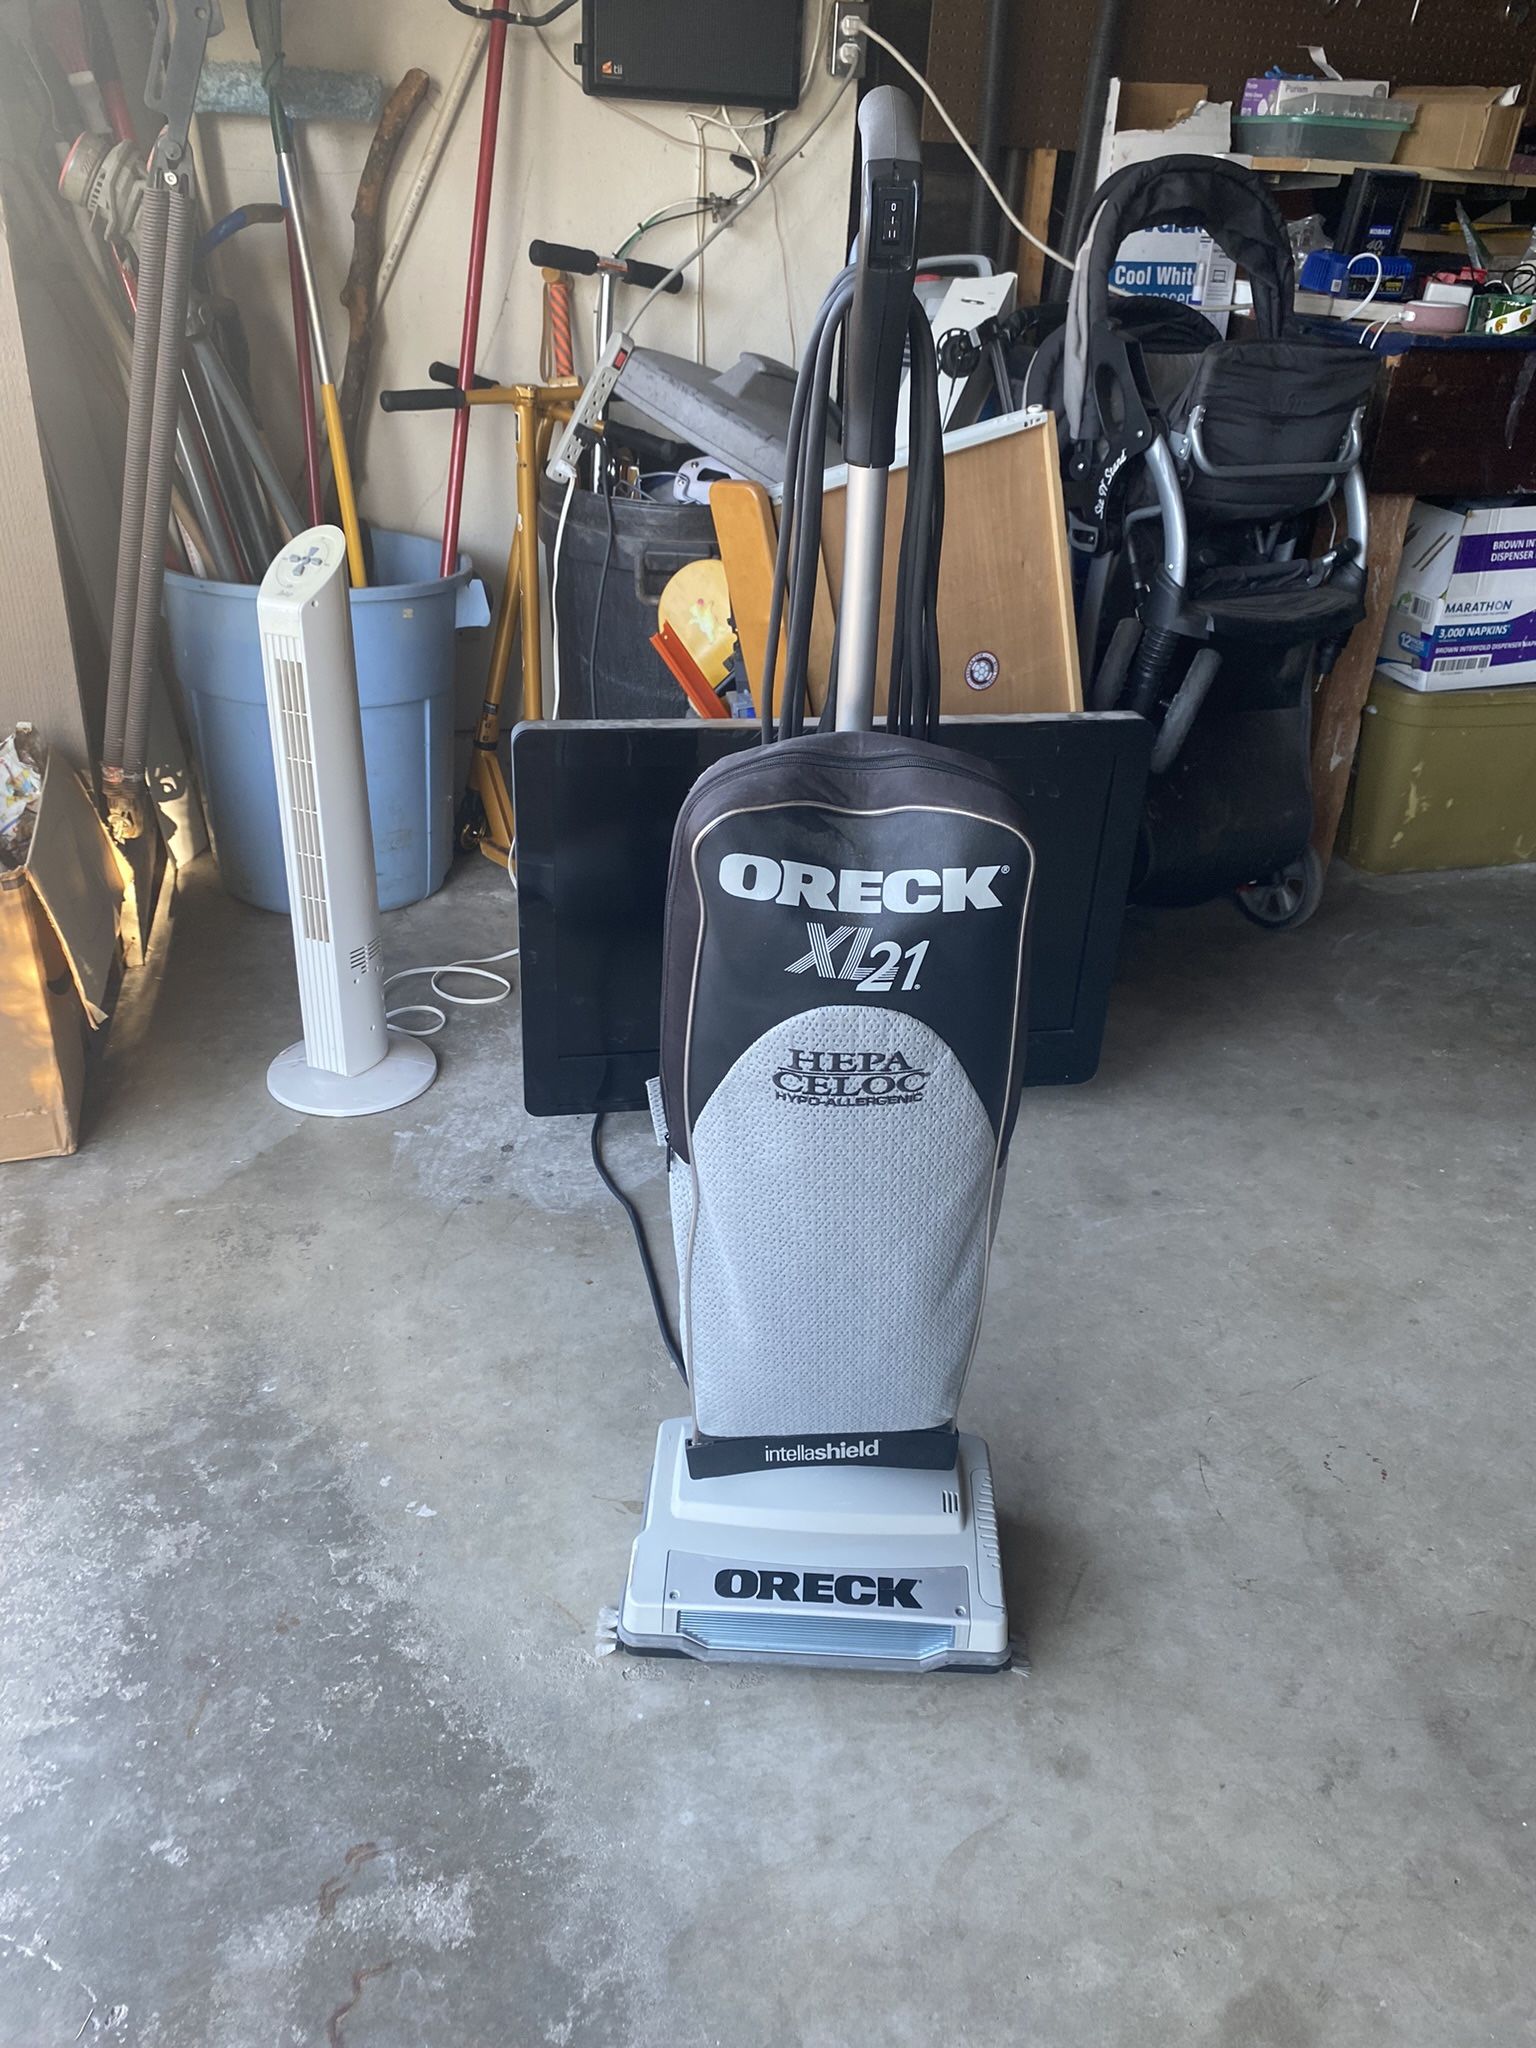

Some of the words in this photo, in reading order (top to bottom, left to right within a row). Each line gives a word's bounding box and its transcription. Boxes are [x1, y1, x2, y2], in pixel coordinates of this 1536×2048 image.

[1114, 264, 1152, 285] Cool
[1156, 265, 1197, 285] Whit
[1104, 447, 1127, 486] Stand
[1492, 540, 1525, 550] BROWN
[1491, 550, 1534, 562] DISPENSER
[1444, 599, 1513, 614] MARATHON
[1438, 627, 1465, 640] 3,000
[1466, 624, 1508, 637] NAPKINS
[1435, 646, 1459, 654] BROWN
[1491, 641, 1521, 650] DISPENSER
[718, 853, 1003, 914] ORECK
[788, 1049, 913, 1073] HEPA
[772, 1071, 931, 1096] CELOC
[775, 1090, 924, 1107] HYPO-ALLERGENIC
[764, 1439, 880, 1462] intellashield
[713, 1568, 923, 1609] ORECK
